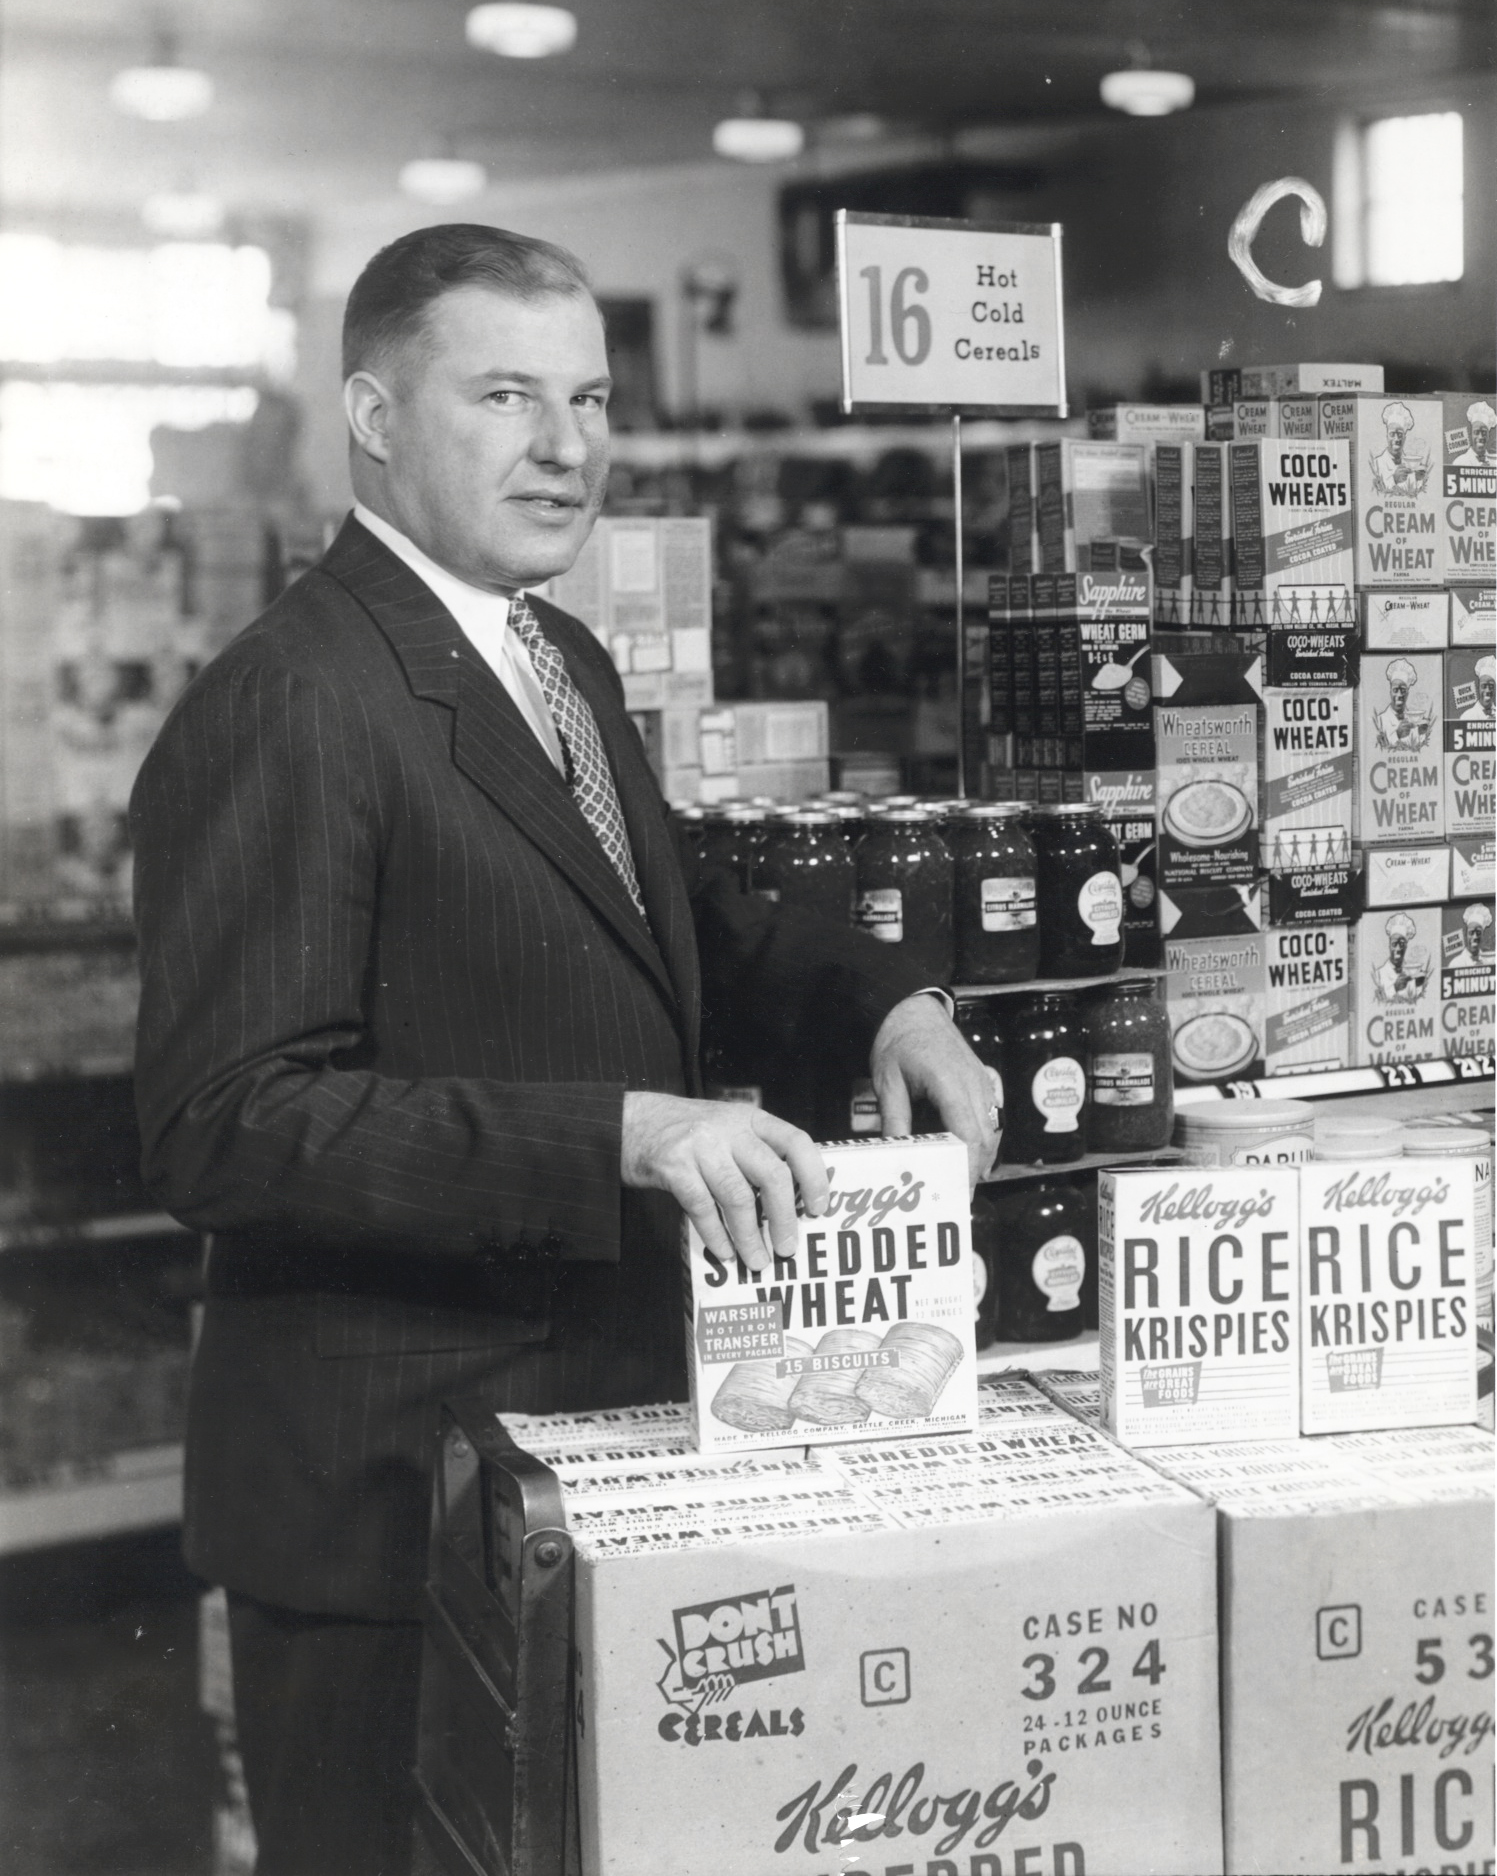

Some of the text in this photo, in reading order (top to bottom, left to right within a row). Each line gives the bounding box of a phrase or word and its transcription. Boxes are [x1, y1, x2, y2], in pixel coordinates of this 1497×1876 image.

[1228, 176, 1327, 307] C
[977, 265, 1017, 289] Hot
[859, 265, 933, 366] 16
[971, 301, 1025, 324] Cold
[954, 339, 1041, 362] Cereals
[1322, 378, 1362, 388] MALTEX
[1237, 404, 1267, 418] CREAM
[1282, 403, 1312, 419] CREAM
[1322, 403, 1354, 418] CREAM
[1238, 421, 1267, 436] WHEAT
[1283, 420, 1313, 436] WHEAT
[1323, 420, 1354, 436] WHEAT
[1450, 431, 1464, 441] QUICK
[1448, 439, 1469, 450] COOKING
[1269, 482, 1347, 506] WHEATS
[1447, 474, 1457, 495] 5
[1365, 505, 1435, 539] CREAM
[1396, 537, 1407, 545] OF
[1290, 550, 1311, 563] COCOA
[1368, 543, 1435, 572] WHEAT
[1080, 575, 1147, 620] Sapphire
[1080, 623, 1147, 640] WHEAT GERM
[1287, 635, 1345, 648] COCO-WHEATS
[1162, 712, 1253, 737] Wheatsworth
[1273, 725, 1348, 750] WHEATS
[1454, 729, 1464, 750] 5
[1184, 741, 1231, 757] CEREAL
[1387, 756, 1418, 764] REGULAR
[1370, 761, 1438, 795] CREAM
[1089, 775, 1152, 819] Sapphire
[1373, 798, 1438, 827] WHEAT
[1125, 823, 1152, 839] GERM
[1199, 867, 1223, 875] BISCUIT
[1225, 865, 1254, 873] COMPANY
[1291, 871, 1348, 888] COCO-WHEATS
[1295, 908, 1342, 918] COCOA COATED
[1168, 946, 1259, 972] Wheatsworth
[1189, 972, 1237, 990] CEREAL
[1269, 959, 1343, 988] WHEATS
[1455, 966, 1491, 976] ENRICHED
[1197, 987, 1245, 997] WHOLE WHEAT
[1443, 979, 1452, 998] 5
[1385, 1008, 1415, 1017] REGULAR
[1366, 1015, 1434, 1048] CREAM
[1469, 1029, 1480, 1037] OF
[1395, 1043, 1406, 1052] OF
[1116, 1078, 1151, 1086] MARMALADE
[1323, 1171, 1451, 1217] Kellogg's
[1139, 1182, 1276, 1231] Kellogg's
[1308, 1219, 1466, 1297] RICE
[1123, 1231, 1289, 1309] RICE
[756, 1275, 912, 1331] WHEAT
[704, 1305, 776, 1325] WARSHIP
[1310, 1296, 1467, 1348] KRISPIES
[706, 1322, 777, 1336] HOT IRON
[1124, 1310, 1290, 1362] KRISPIES
[704, 1334, 780, 1352] TRANSFER
[703, 1347, 783, 1361] IN EVERY PACKAGE
[784, 1352, 891, 1374] 15 BISCUITS
[1343, 1351, 1378, 1363] GRAINS
[1158, 1367, 1194, 1379] GRAINS
[1343, 1363, 1378, 1375] GREAT
[1343, 1374, 1378, 1385] FOODS
[1158, 1379, 1194, 1389] GREAT
[1158, 1389, 1194, 1399] FOODS
[714, 1434, 737, 1442] MADE
[760, 1428, 799, 1438] KELLOGG
[804, 1424, 847, 1434] COMPANY,
[852, 1421, 884, 1430] BATTLE
[888, 1418, 919, 1427] CREEK,
[924, 1413, 967, 1423] MICHIGAN
[838, 1431, 1100, 1467] SHREDDED WHEAT
[849, 1443, 1110, 1477] SHREDDED WHEAT
[872, 1464, 1140, 1498] SHREDDED WHEAT
[570, 1504, 678, 1524] WHEAT
[595, 1529, 706, 1549] WHEAT
[1413, 1593, 1487, 1620] CASE
[679, 1590, 797, 1651] DON'T
[1023, 1602, 1158, 1641] CASE NO
[1328, 1617, 1349, 1648] C
[682, 1629, 798, 1677] CRUSH
[873, 1660, 896, 1692] C
[1095, 1699, 1163, 1724] OUNCE
[657, 1707, 805, 1746] CEREALS
[1023, 1721, 1162, 1756] PACKAGES
[773, 1759, 1057, 1856] Kellogg's
[1339, 1768, 1496, 1864] RIC
